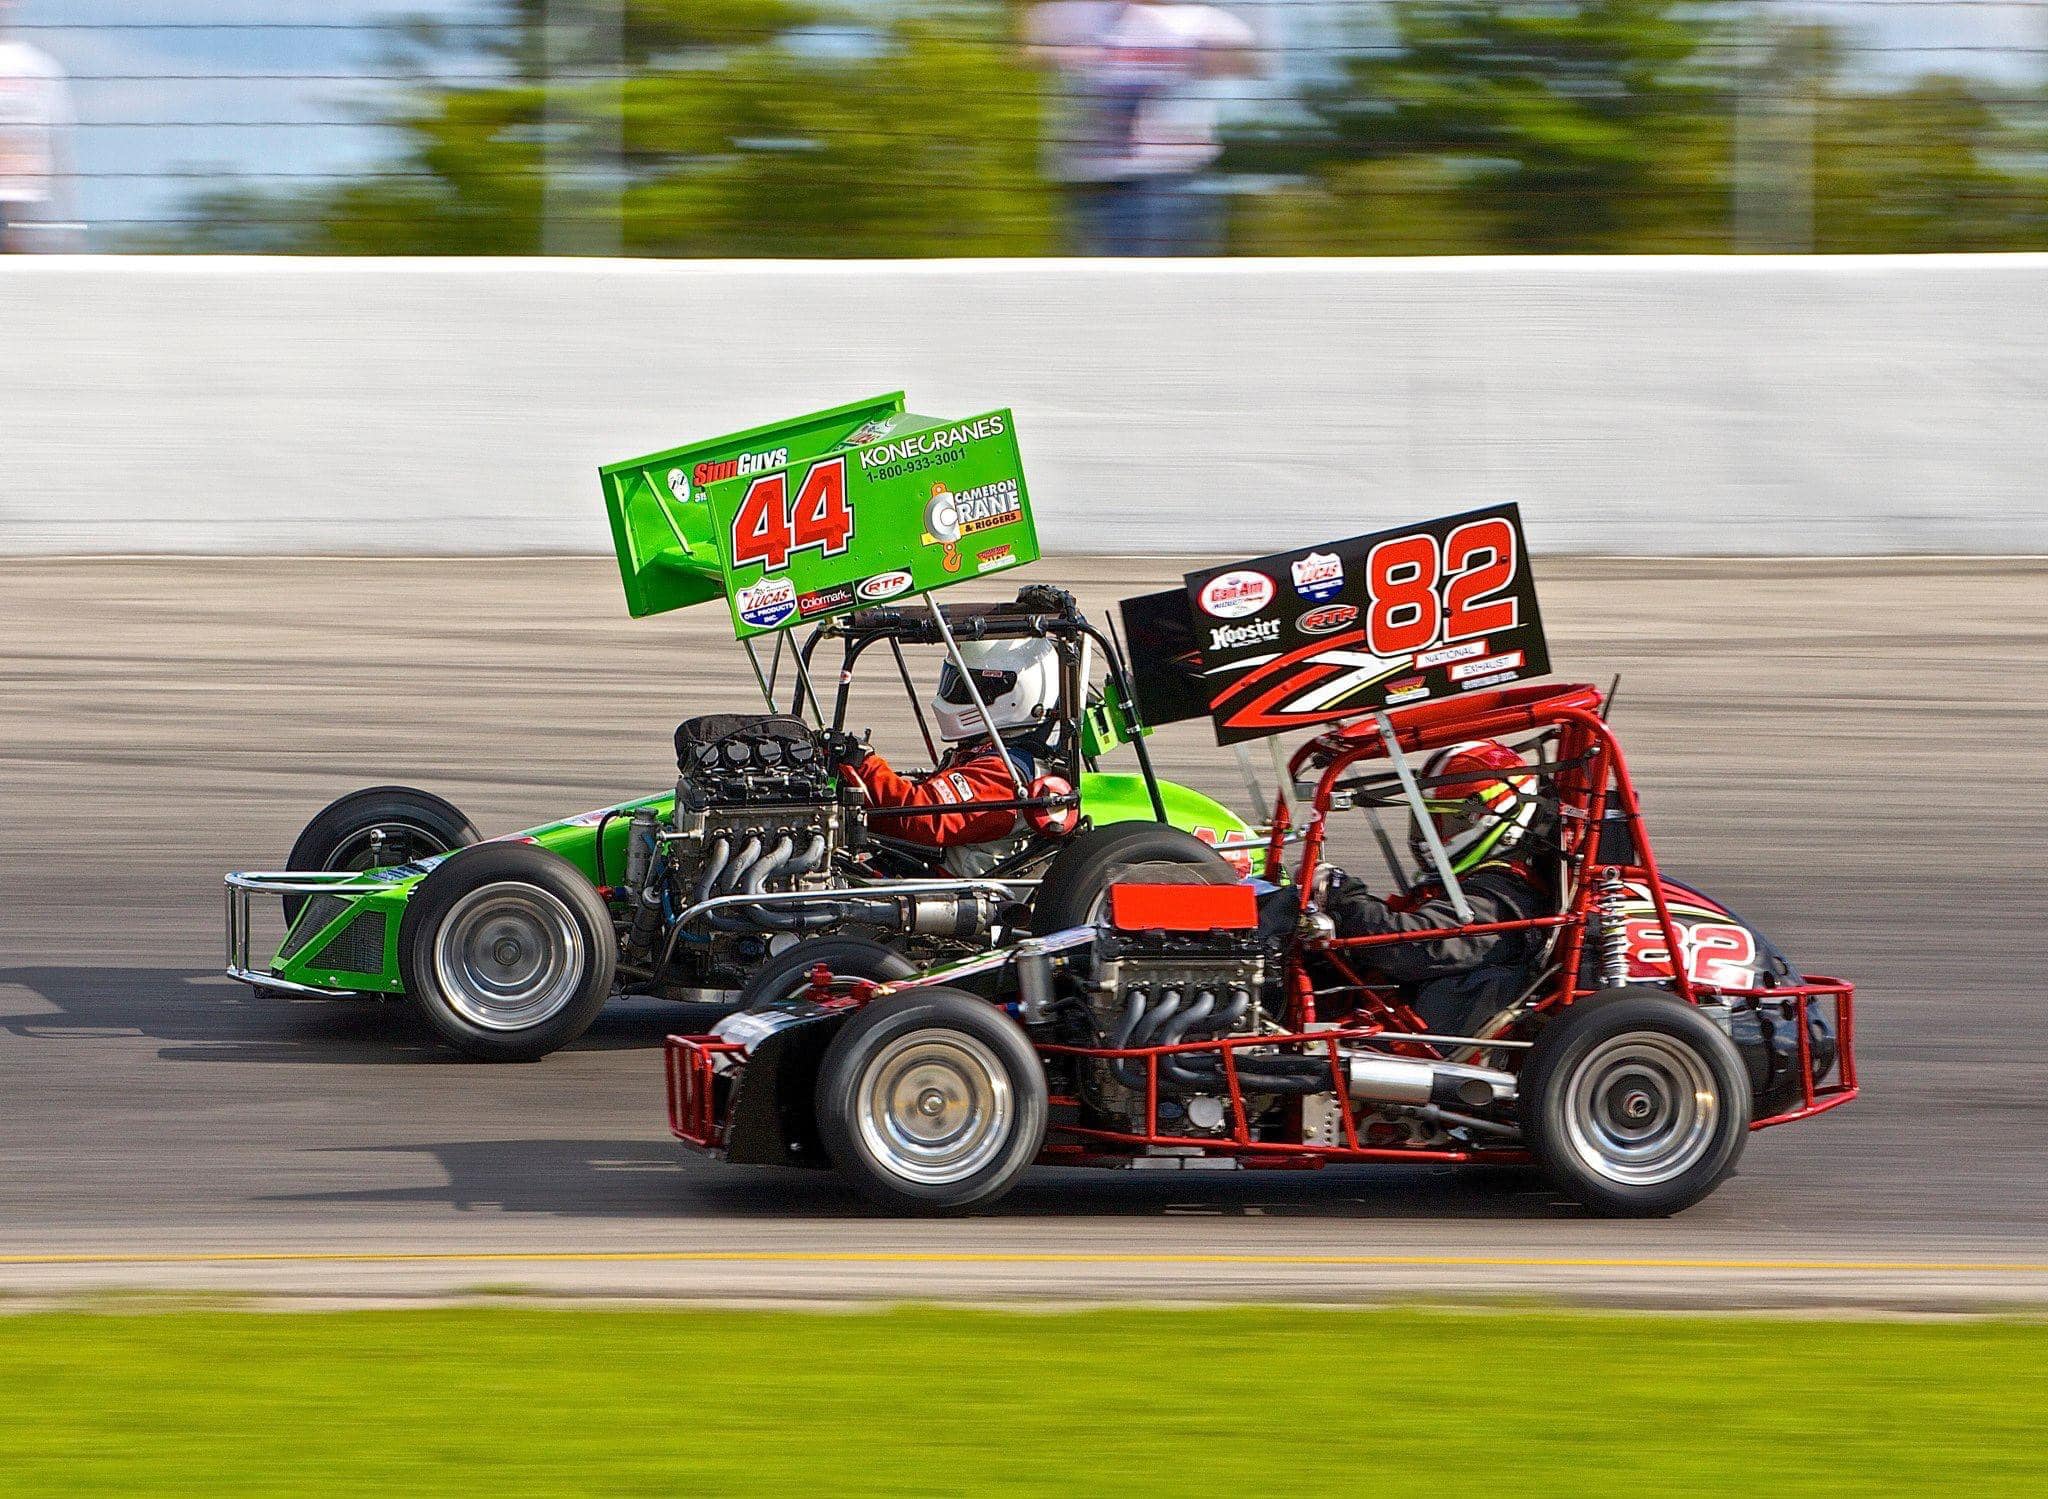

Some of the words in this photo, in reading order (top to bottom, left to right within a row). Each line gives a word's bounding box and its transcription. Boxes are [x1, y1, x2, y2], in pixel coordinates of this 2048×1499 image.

[859, 416, 1004, 470] KONECRANES
[866, 448, 966, 483] 1-800-933-3001
[954, 478, 1017, 504] CAMERON
[731, 455, 855, 573] 44
[975, 511, 1017, 530] RIGGERS
[867, 576, 905, 593] RTR
[1365, 516, 1518, 658] 82
[746, 588, 790, 610] LUCAS
[800, 590, 847, 609] Colormark
[743, 611, 757, 620] OIL
[1305, 606, 1359, 628] RTR
[1624, 918, 1756, 989] 82
